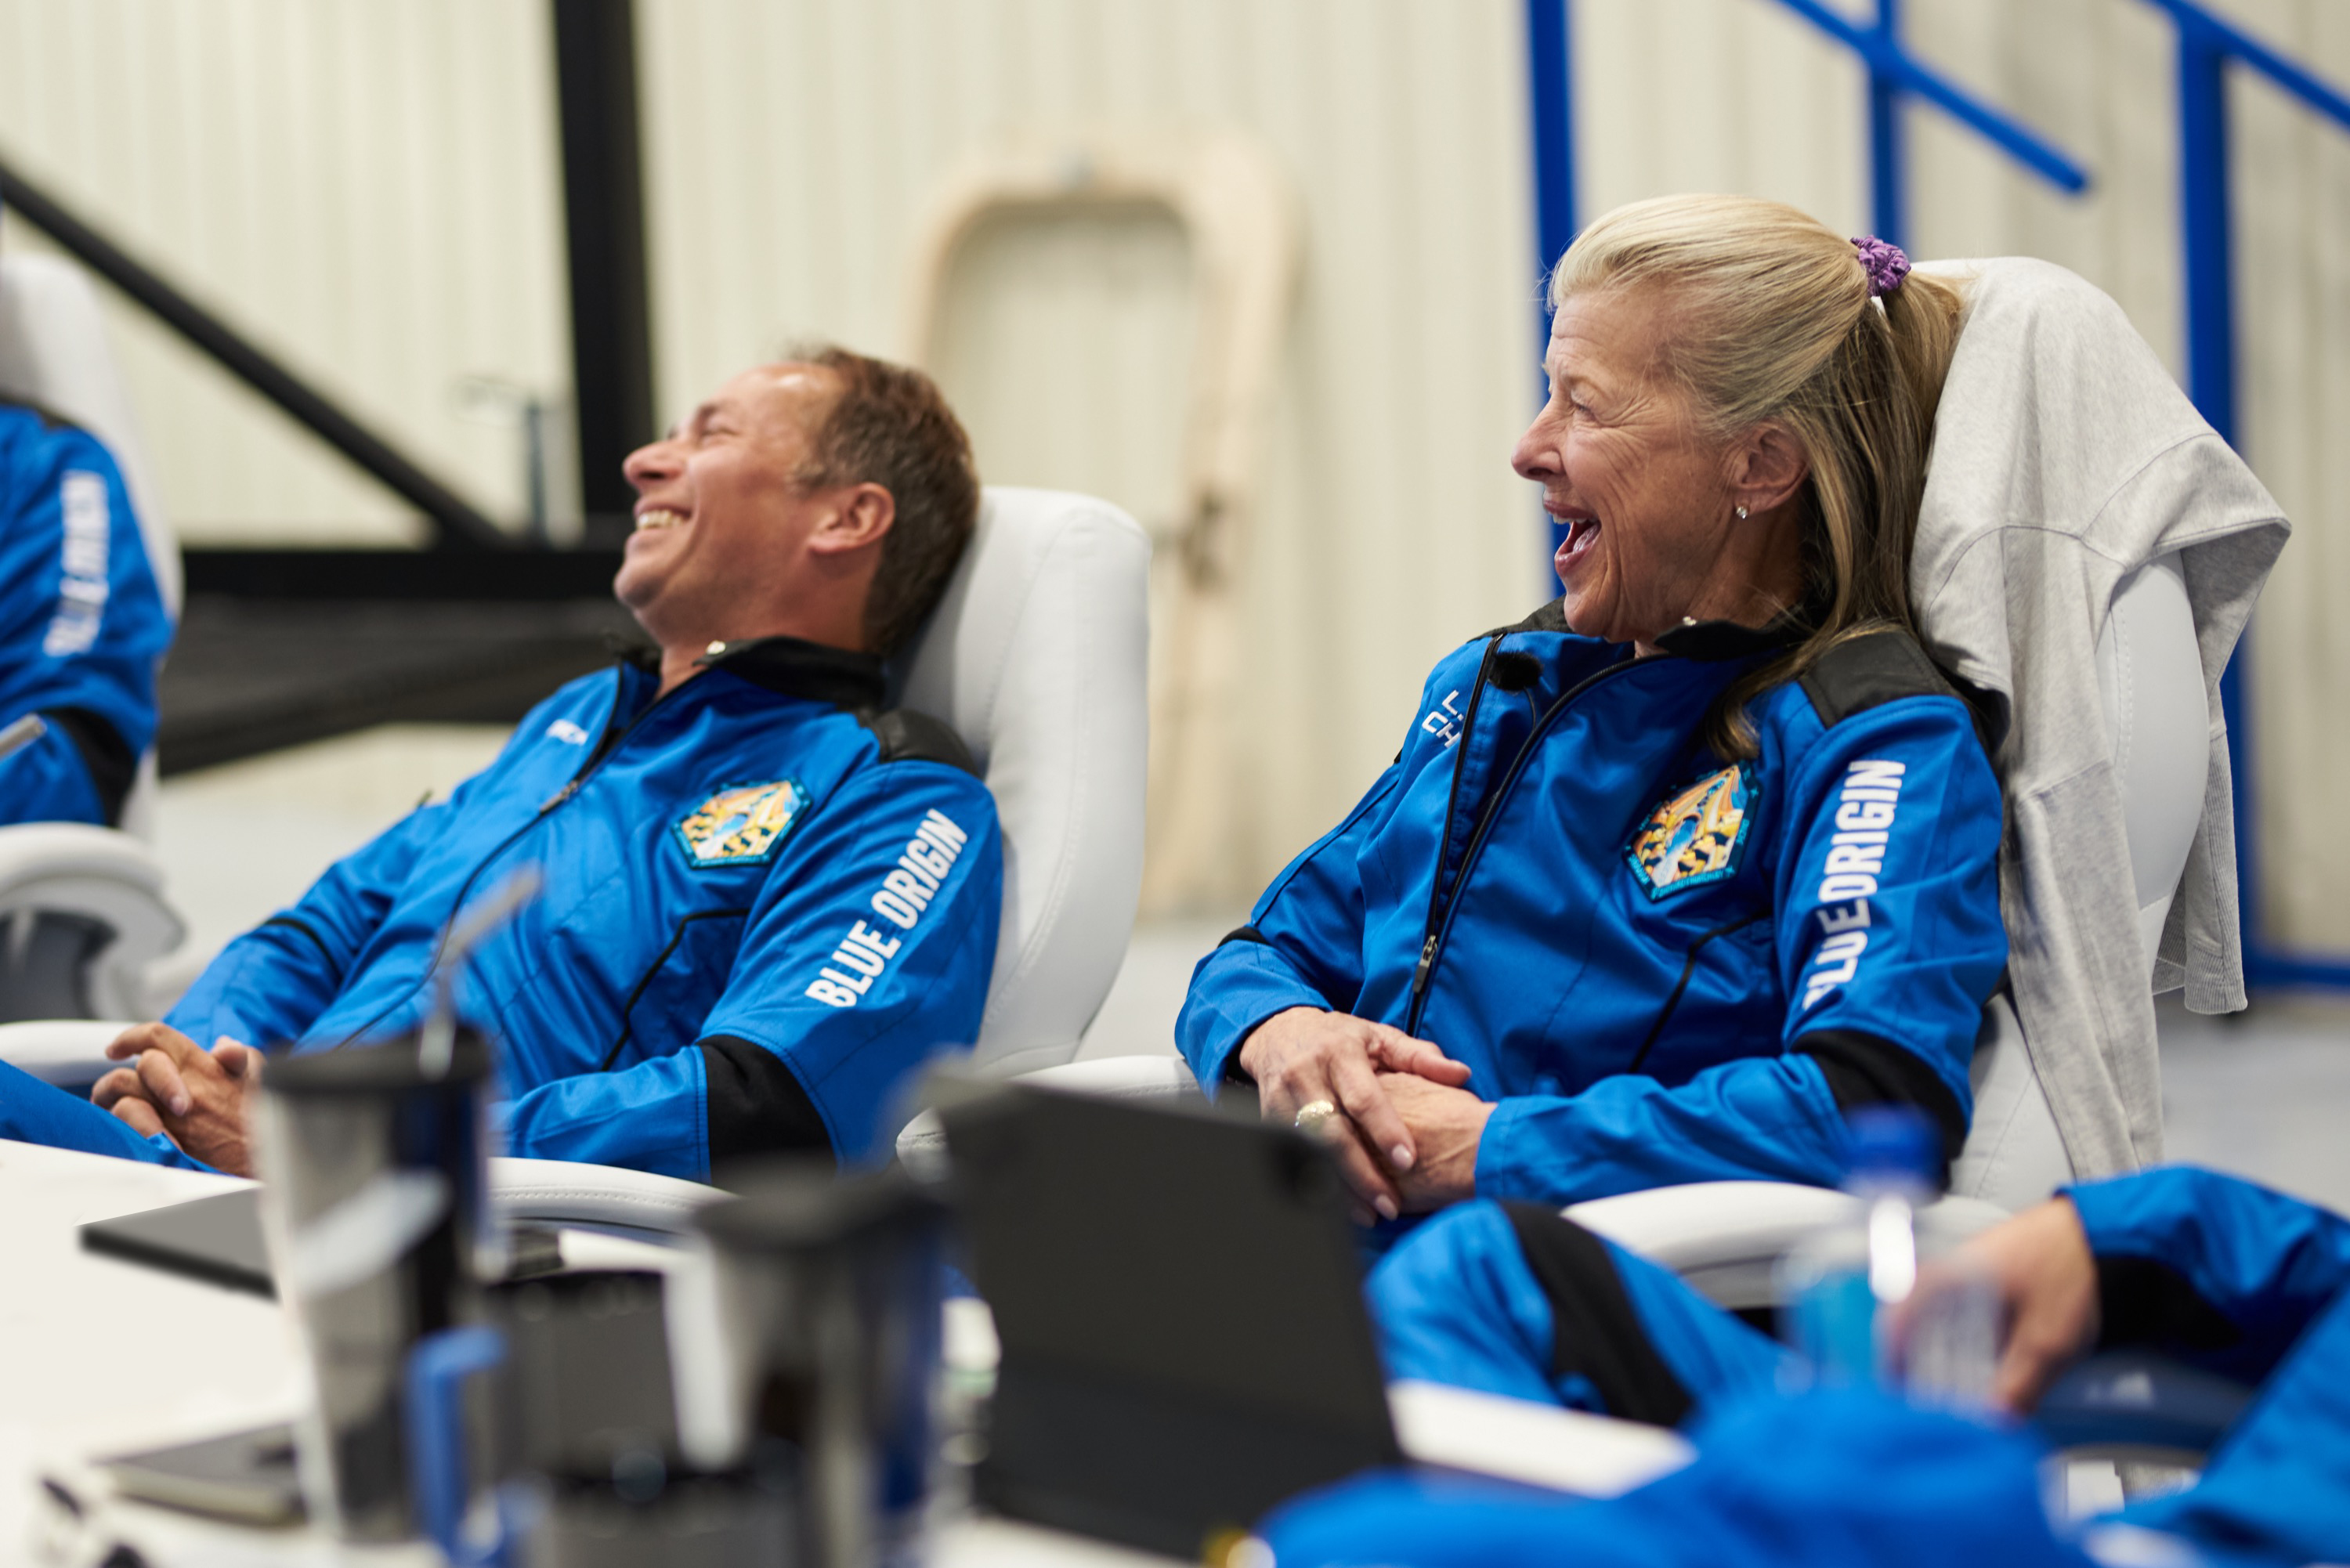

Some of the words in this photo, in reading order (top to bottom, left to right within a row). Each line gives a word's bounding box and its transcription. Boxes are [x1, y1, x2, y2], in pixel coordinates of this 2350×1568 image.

[804, 919, 902, 1008] BLUE
[870, 807, 968, 930] ORIGIN
[1818, 759, 1906, 903] ORIGIN
